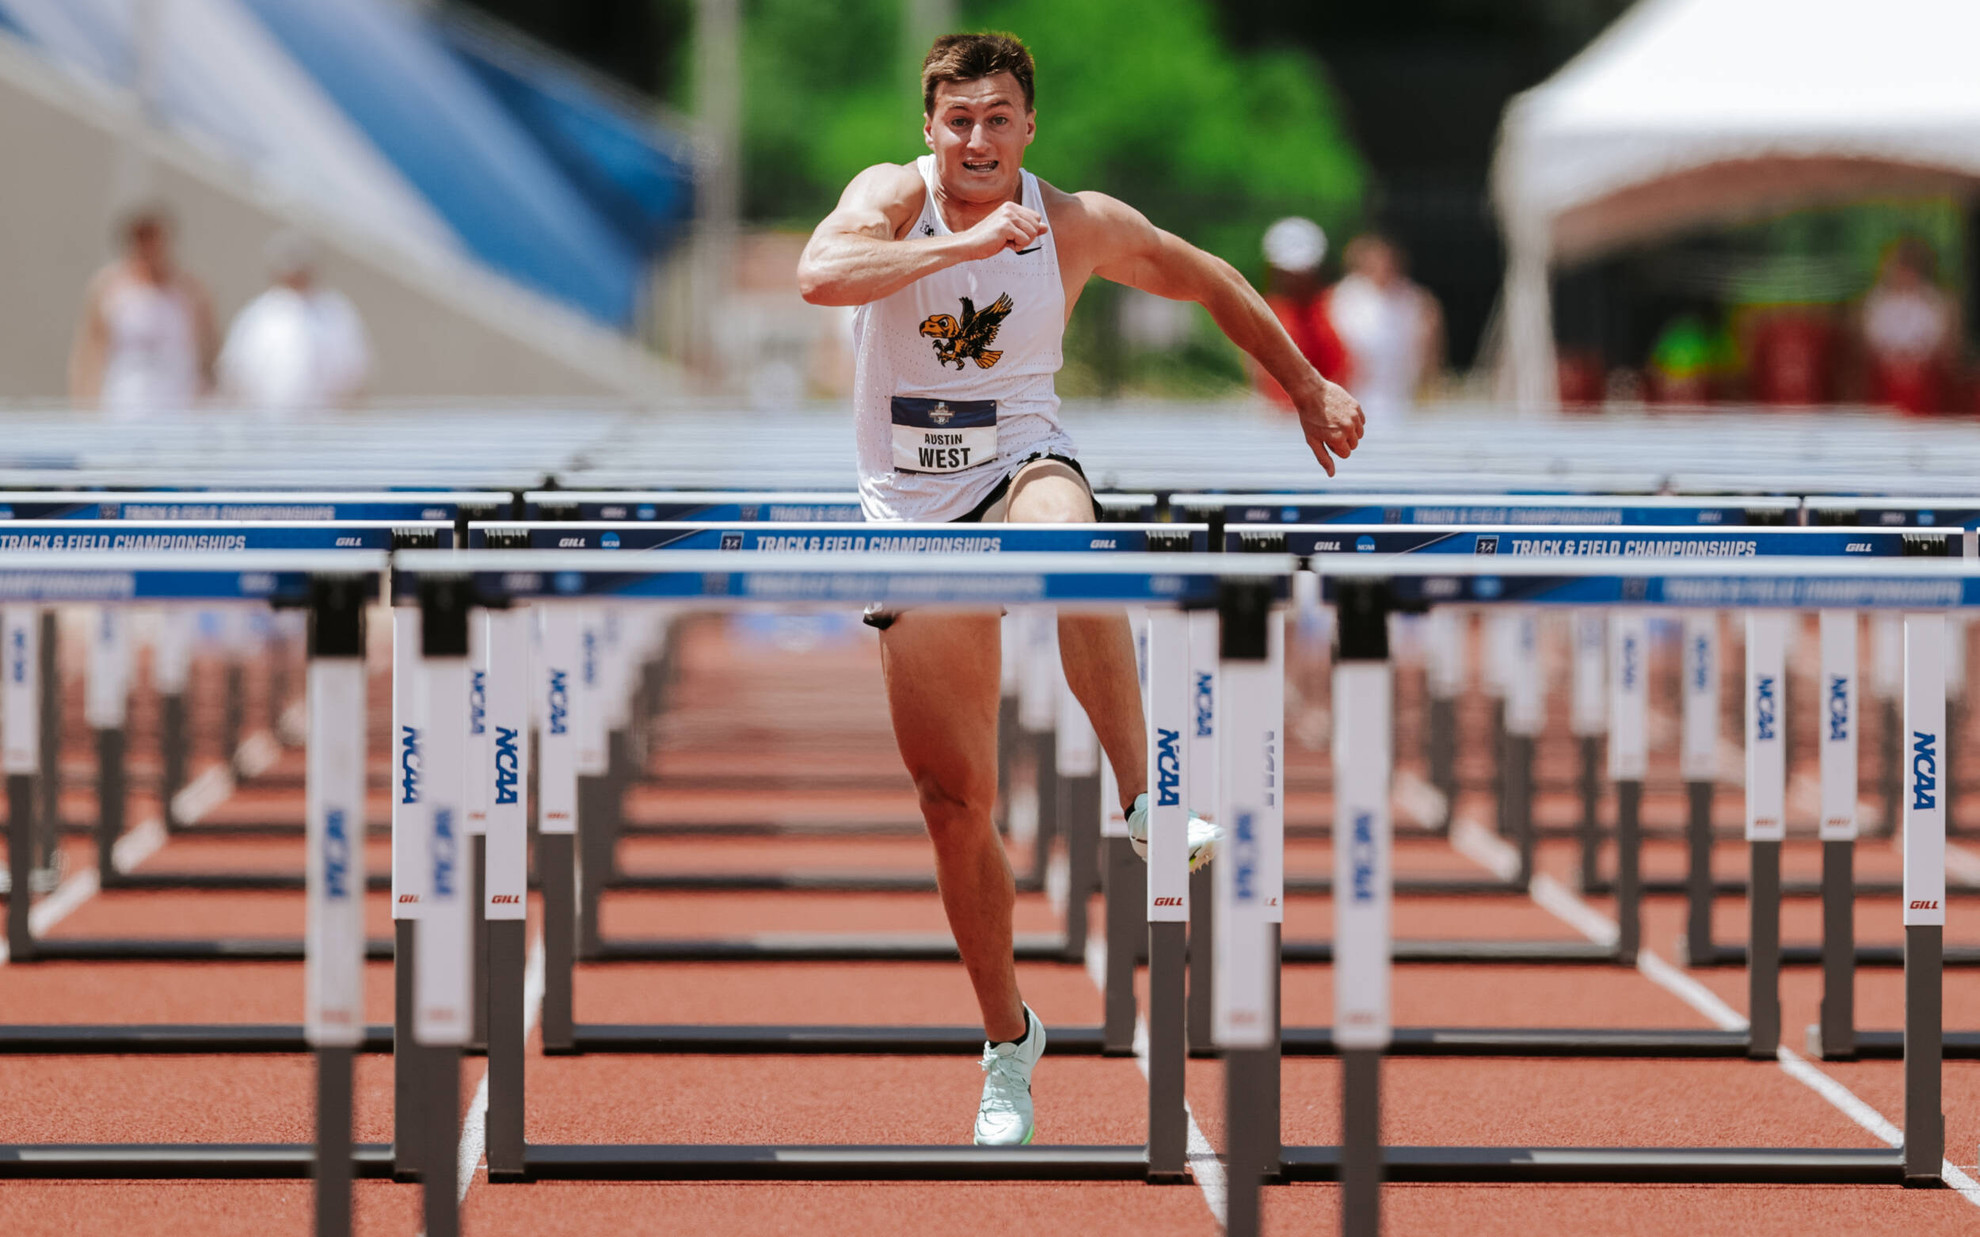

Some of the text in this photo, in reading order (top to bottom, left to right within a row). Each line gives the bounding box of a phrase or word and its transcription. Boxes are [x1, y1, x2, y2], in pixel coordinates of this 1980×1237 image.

[924, 433, 963, 446] AUSTIN
[918, 447, 971, 469] WEST
[0, 535, 247, 551] TRACK & FIELD CHAMPIONSHIPS
[335, 537, 363, 547] GILL
[558, 538, 586, 548] GILL
[756, 536, 1002, 553] TRACK & FIELD CHAMPIONSHIPS
[1090, 539, 1117, 549] GILL
[1314, 541, 1342, 551] GILL
[1511, 540, 1758, 557] TRACK & FIELD CHAMPIONSHIPS
[1845, 543, 1873, 552] GILL
[470, 670, 486, 735] NCAA
[549, 669, 568, 735] NCAA
[1196, 672, 1213, 737] NCAA
[1757, 674, 1775, 741] NCAA
[1830, 674, 1848, 741] NCAA
[495, 726, 518, 804] NCAA
[1157, 728, 1180, 807] NCAA
[1913, 731, 1936, 810] NCAA
[491, 895, 520, 904] GILL
[1153, 897, 1183, 906] GILL
[1909, 900, 1939, 910] GILL
